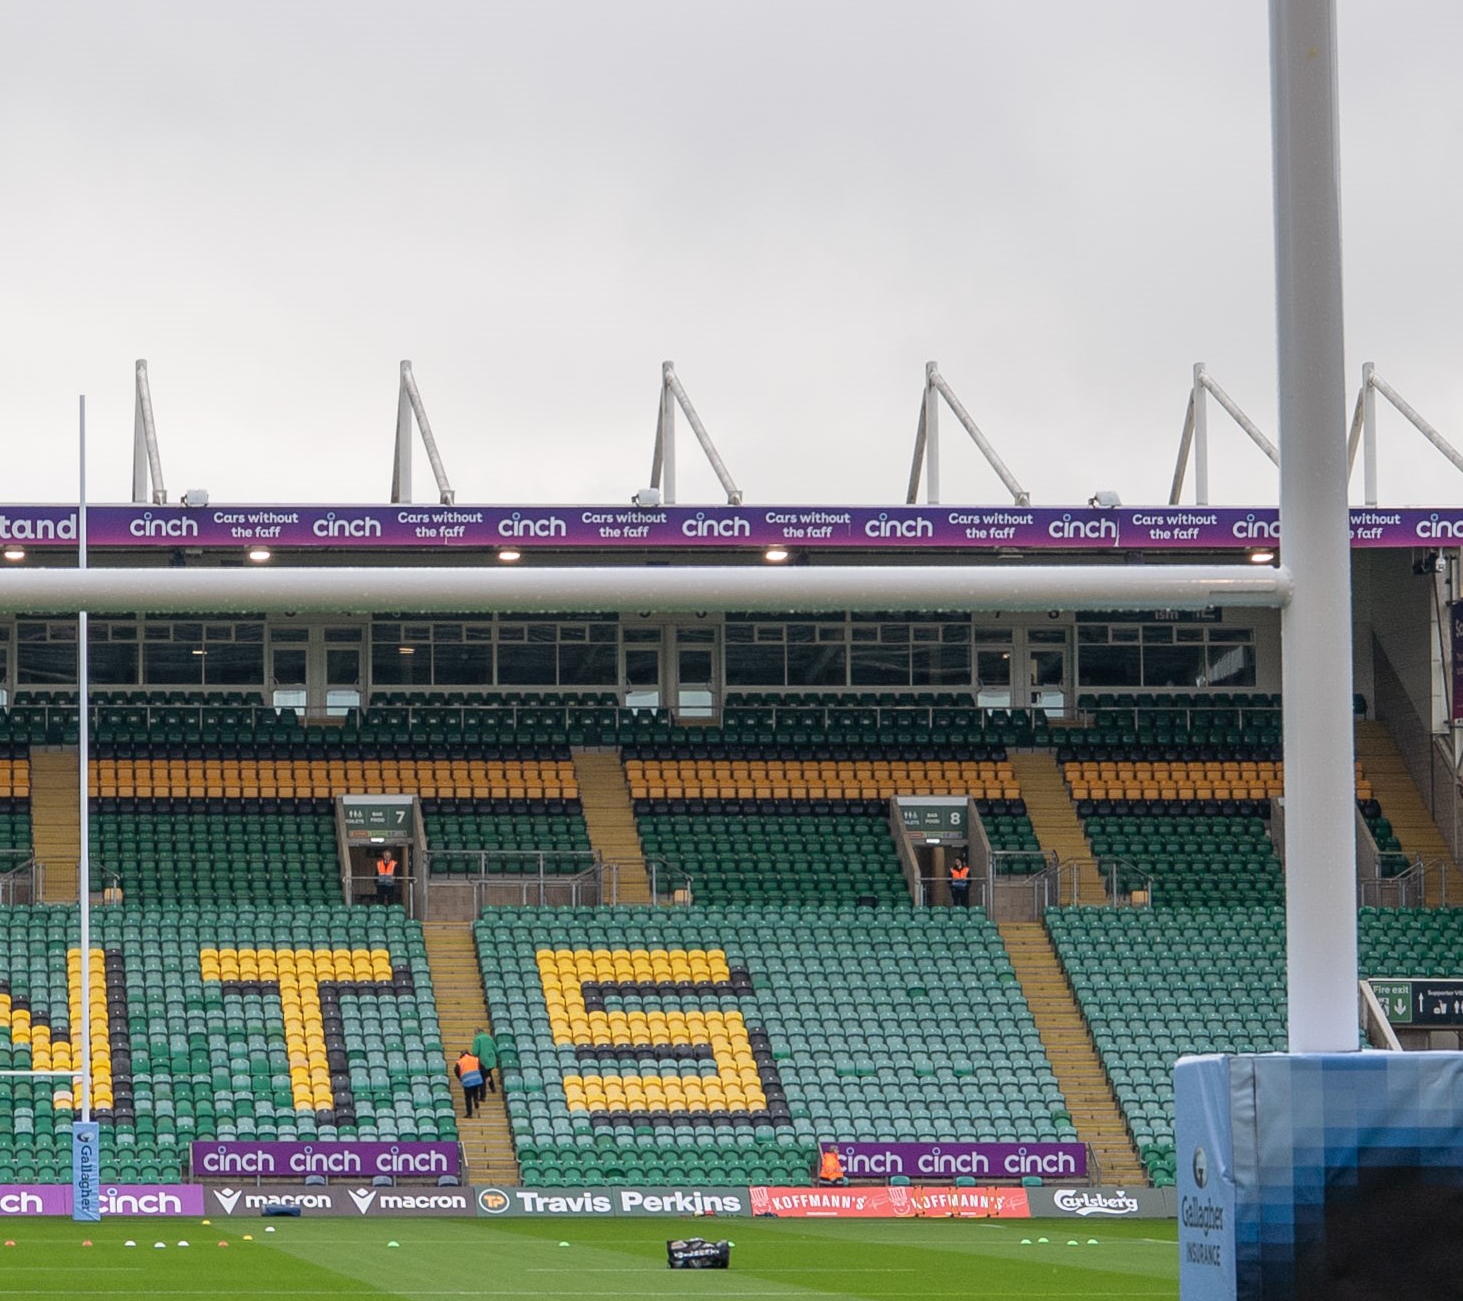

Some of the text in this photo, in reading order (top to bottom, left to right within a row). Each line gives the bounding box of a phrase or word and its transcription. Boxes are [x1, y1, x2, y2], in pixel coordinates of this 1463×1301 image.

[130, 512, 197, 537] cinch
[314, 512, 381, 537] cinch
[499, 512, 566, 537] cinch
[683, 512, 750, 538] cinch
[865, 512, 933, 538] cinch
[1049, 512, 1117, 538] cinch
[396, 811, 405, 824] 7
[950, 812, 961, 825] 8
[1373, 985, 1409, 995] Fire exit
[1427, 989, 1453, 997] Supporter
[203, 1145, 275, 1173] cinch
[290, 1145, 361, 1173] cinch
[376, 1145, 447, 1173] cinch
[838, 1147, 903, 1173] cinch
[918, 1147, 990, 1174] cinch
[1004, 1147, 1075, 1174] cinch
[79, 1145, 91, 1211] Gallagher
[98, 1187, 181, 1214] cinch
[245, 1193, 331, 1209] macron
[380, 1193, 466, 1209] macron
[516, 1190, 741, 1213] Travis Perkins
[772, 1195, 866, 1211] KOFFMANN'S
[1053, 1190, 1139, 1216] Carlsberg
[1181, 1195, 1224, 1237] Gallagher
[1186, 1241, 1221, 1268] INSURANCE
